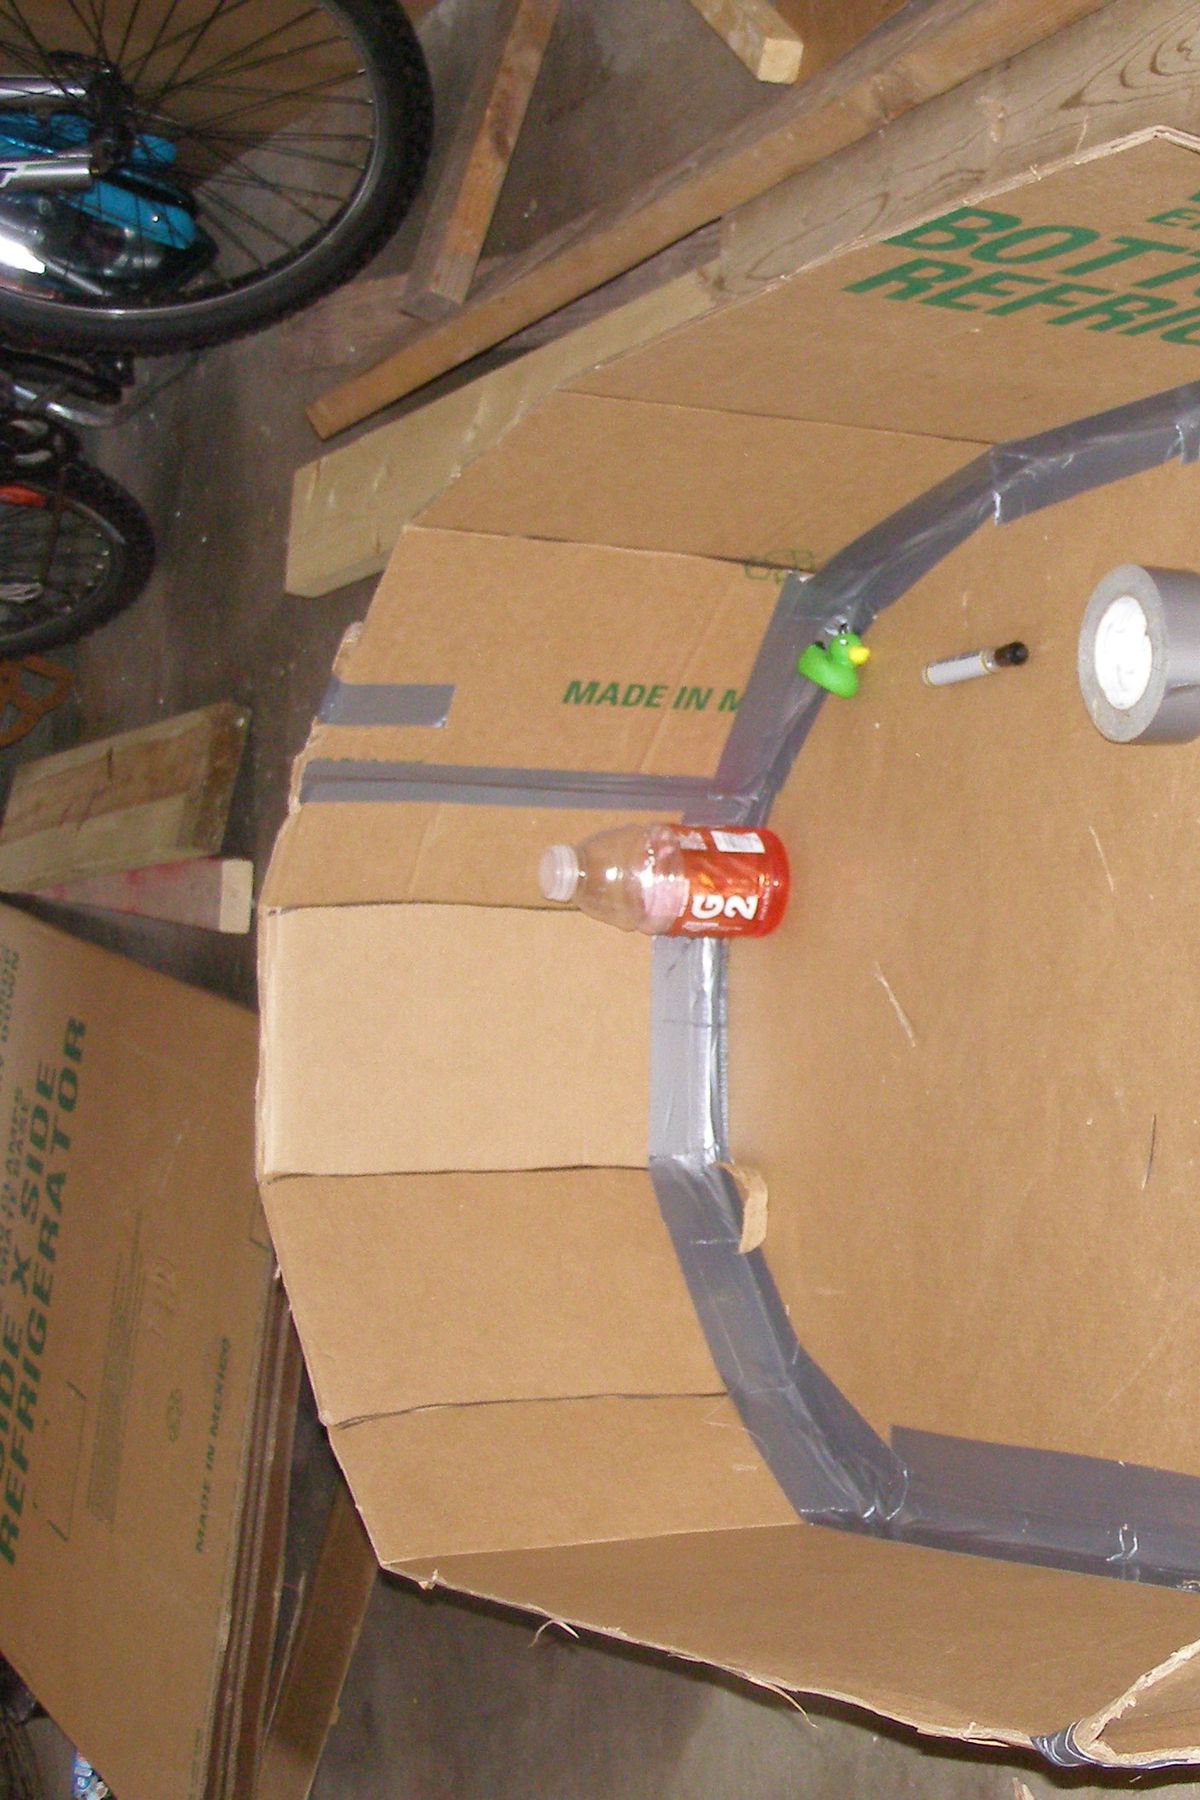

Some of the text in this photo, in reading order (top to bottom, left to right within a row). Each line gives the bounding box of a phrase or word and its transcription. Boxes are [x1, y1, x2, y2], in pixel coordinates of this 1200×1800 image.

[562, 680, 668, 709] MADE
[672, 686, 714, 712] IN
[20, 1060, 56, 1226] SIDE
[0, 1017, 86, 1566] REFRIGERATOR
[10, 1245, 33, 1298] X
[195, 1336, 230, 1553] MADE IN MEXICO
